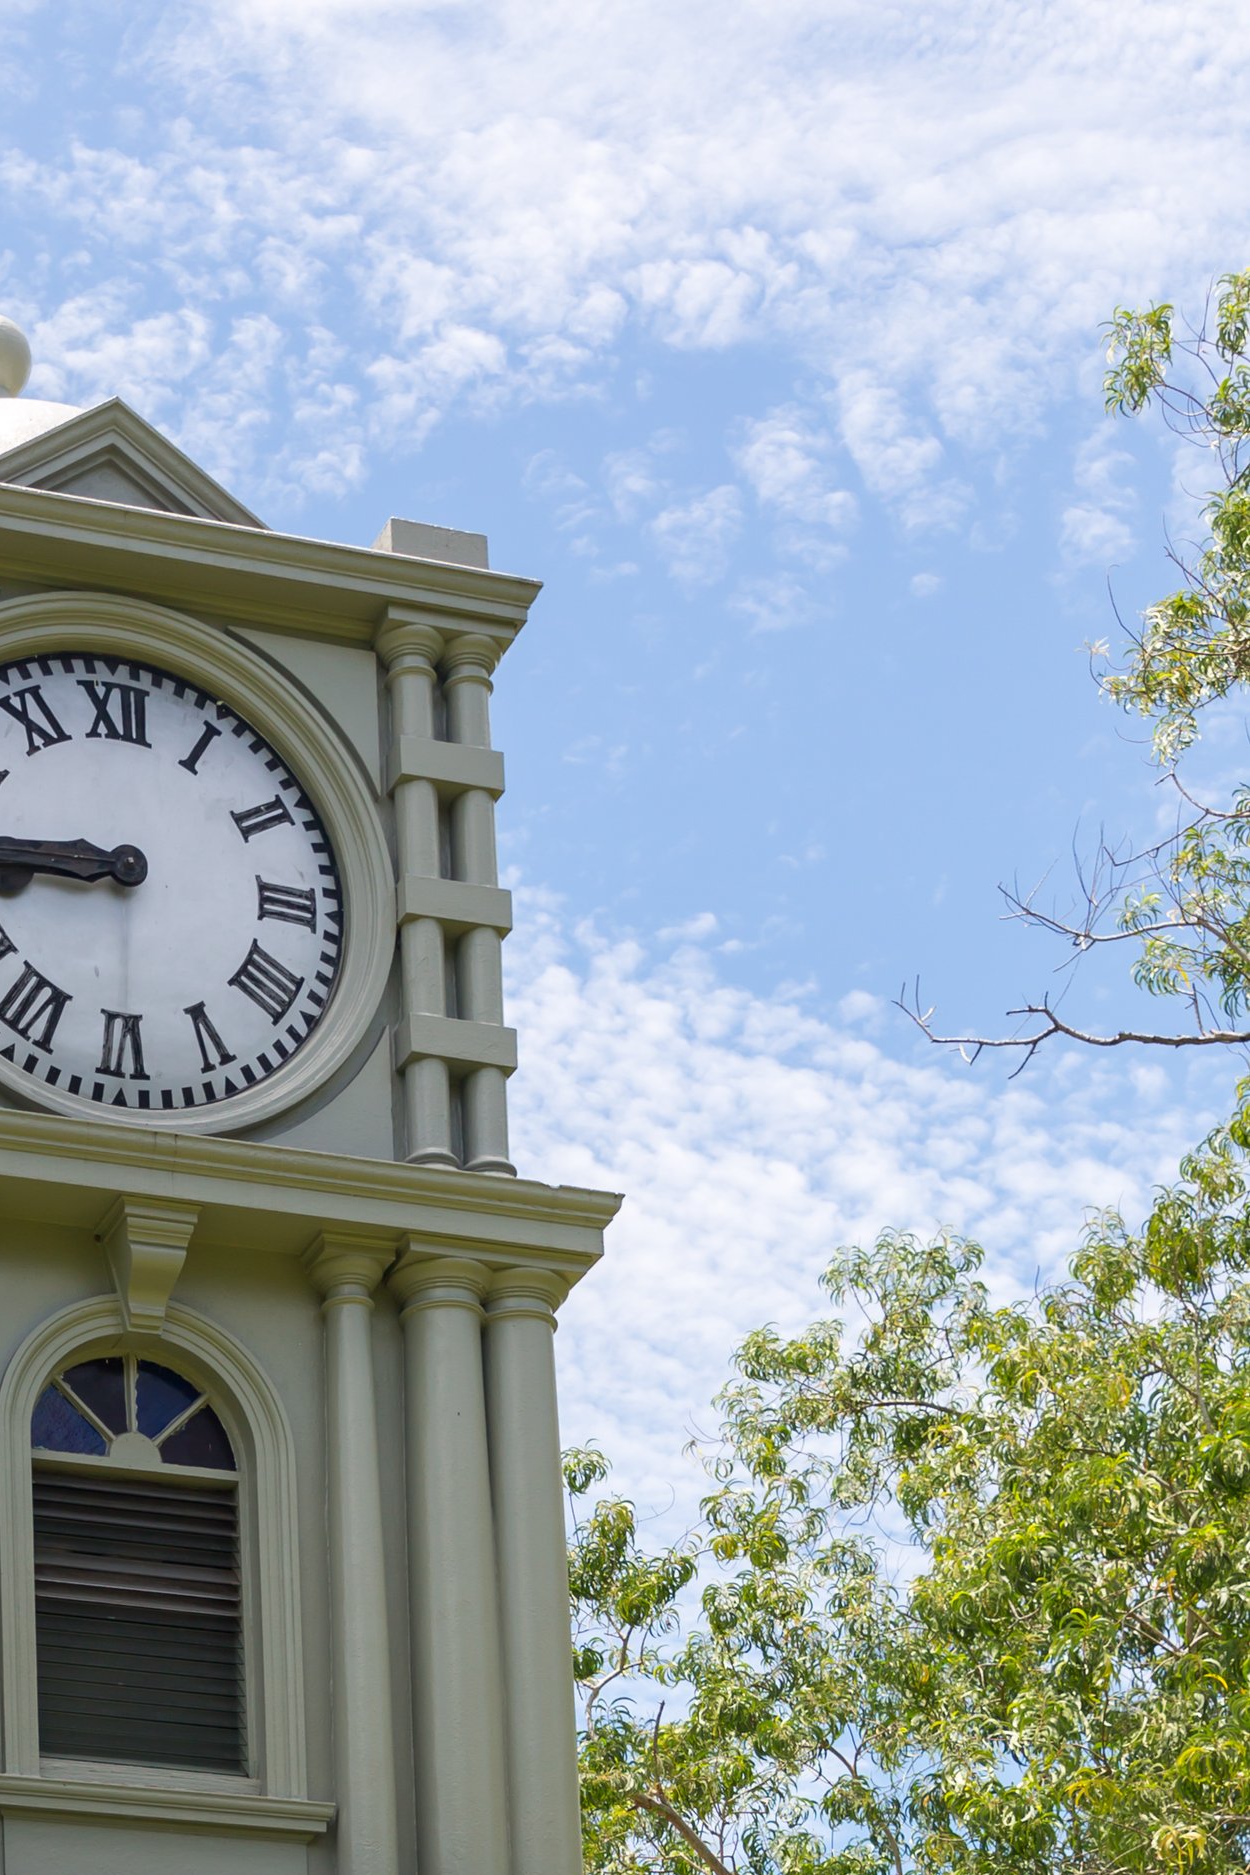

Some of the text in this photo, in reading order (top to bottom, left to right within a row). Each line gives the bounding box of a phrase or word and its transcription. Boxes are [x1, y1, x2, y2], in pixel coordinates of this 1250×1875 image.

[76, 679, 152, 749] XII
[178, 720, 222, 775] I
[230, 795, 295, 843] II
[256, 875, 317, 934] III
[227, 938, 305, 1026] IIII
[95, 1008, 151, 1080] VI
[184, 1001, 237, 1074] V
